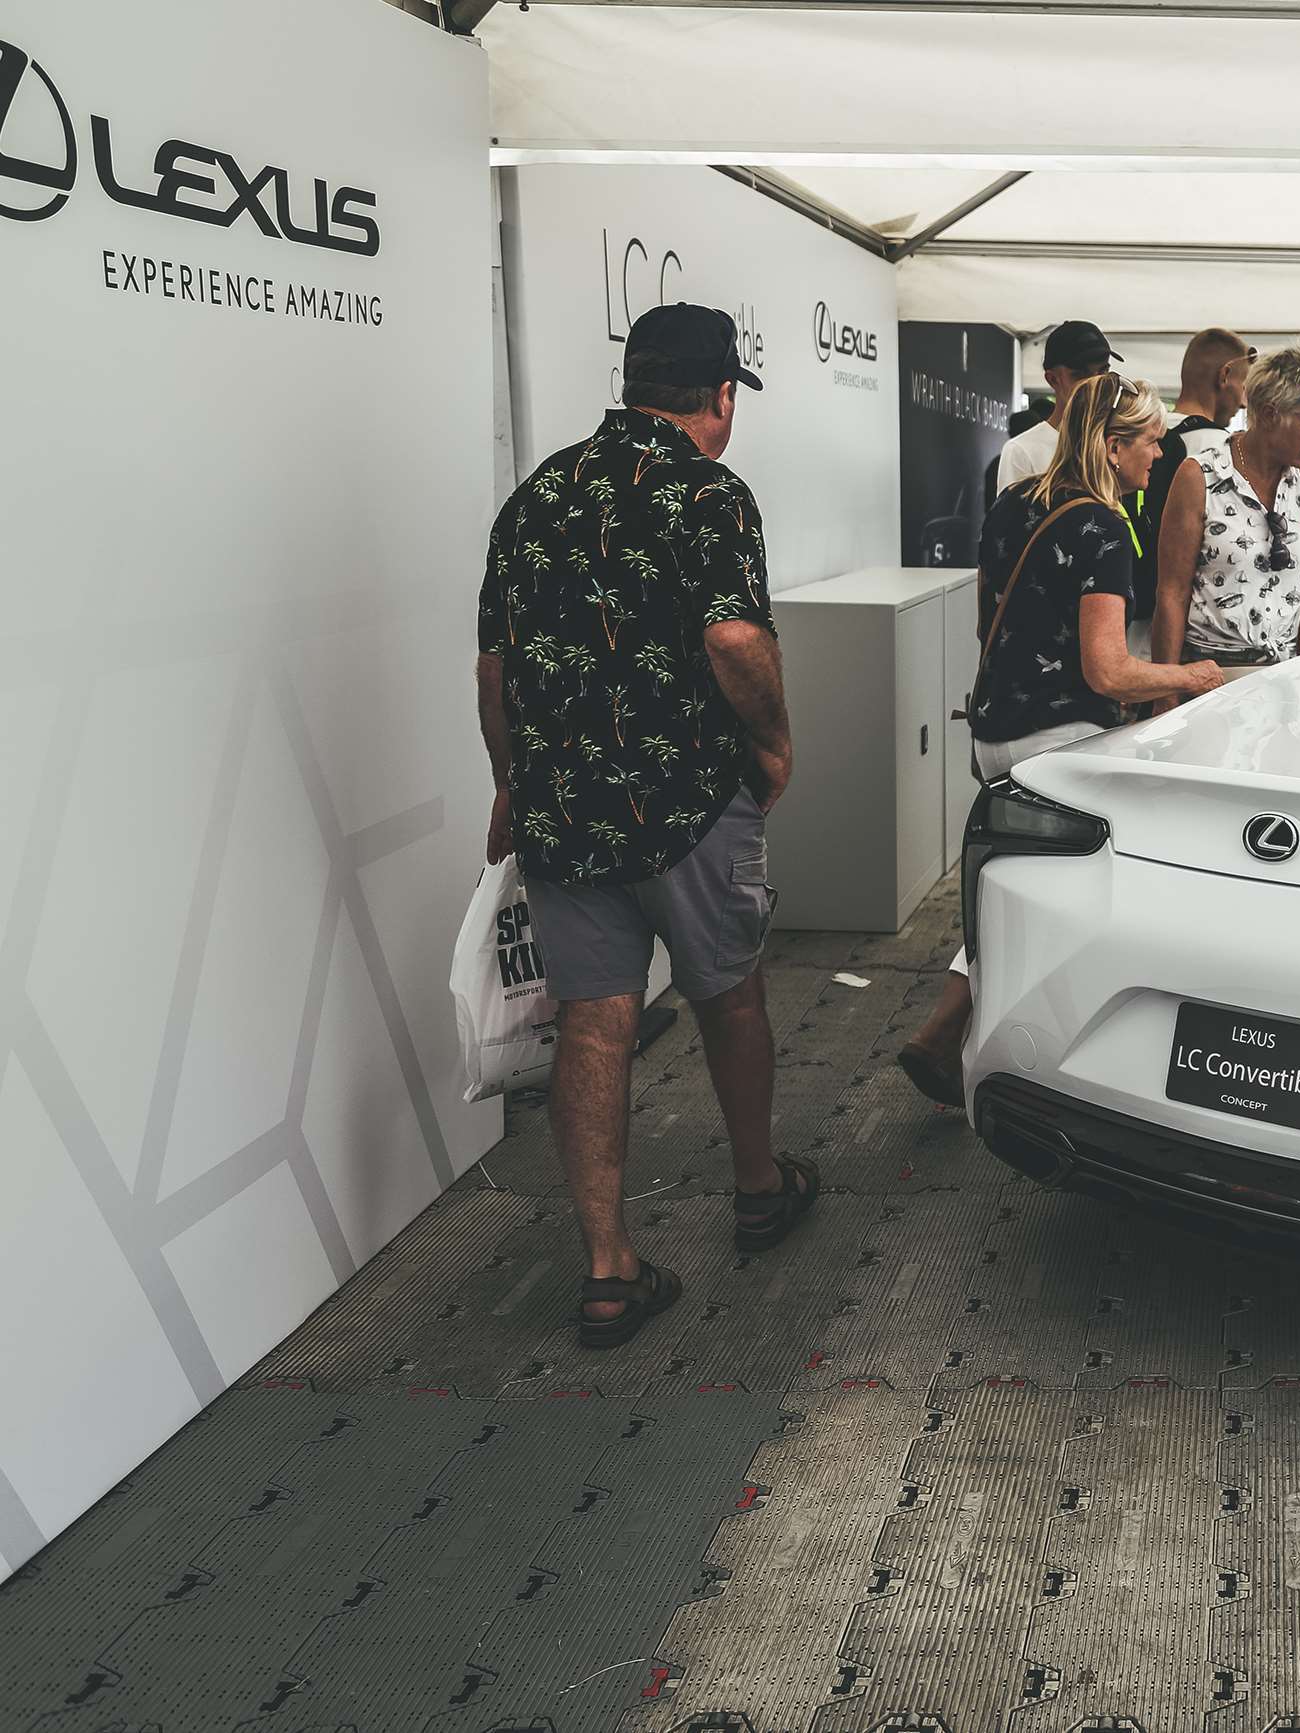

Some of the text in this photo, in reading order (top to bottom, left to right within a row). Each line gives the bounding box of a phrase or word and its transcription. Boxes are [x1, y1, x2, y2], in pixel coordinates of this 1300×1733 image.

[91, 114, 380, 257] LEXUS
[103, 250, 383, 326] EXPERIENCE AMAZING
[833, 321, 877, 361] LEXUS
[912, 369, 952, 416] WRAITH
[1231, 1026, 1276, 1049] LEXUS
[1177, 1045, 1202, 1071] LC
[1220, 1094, 1268, 1112] CONCEPT
